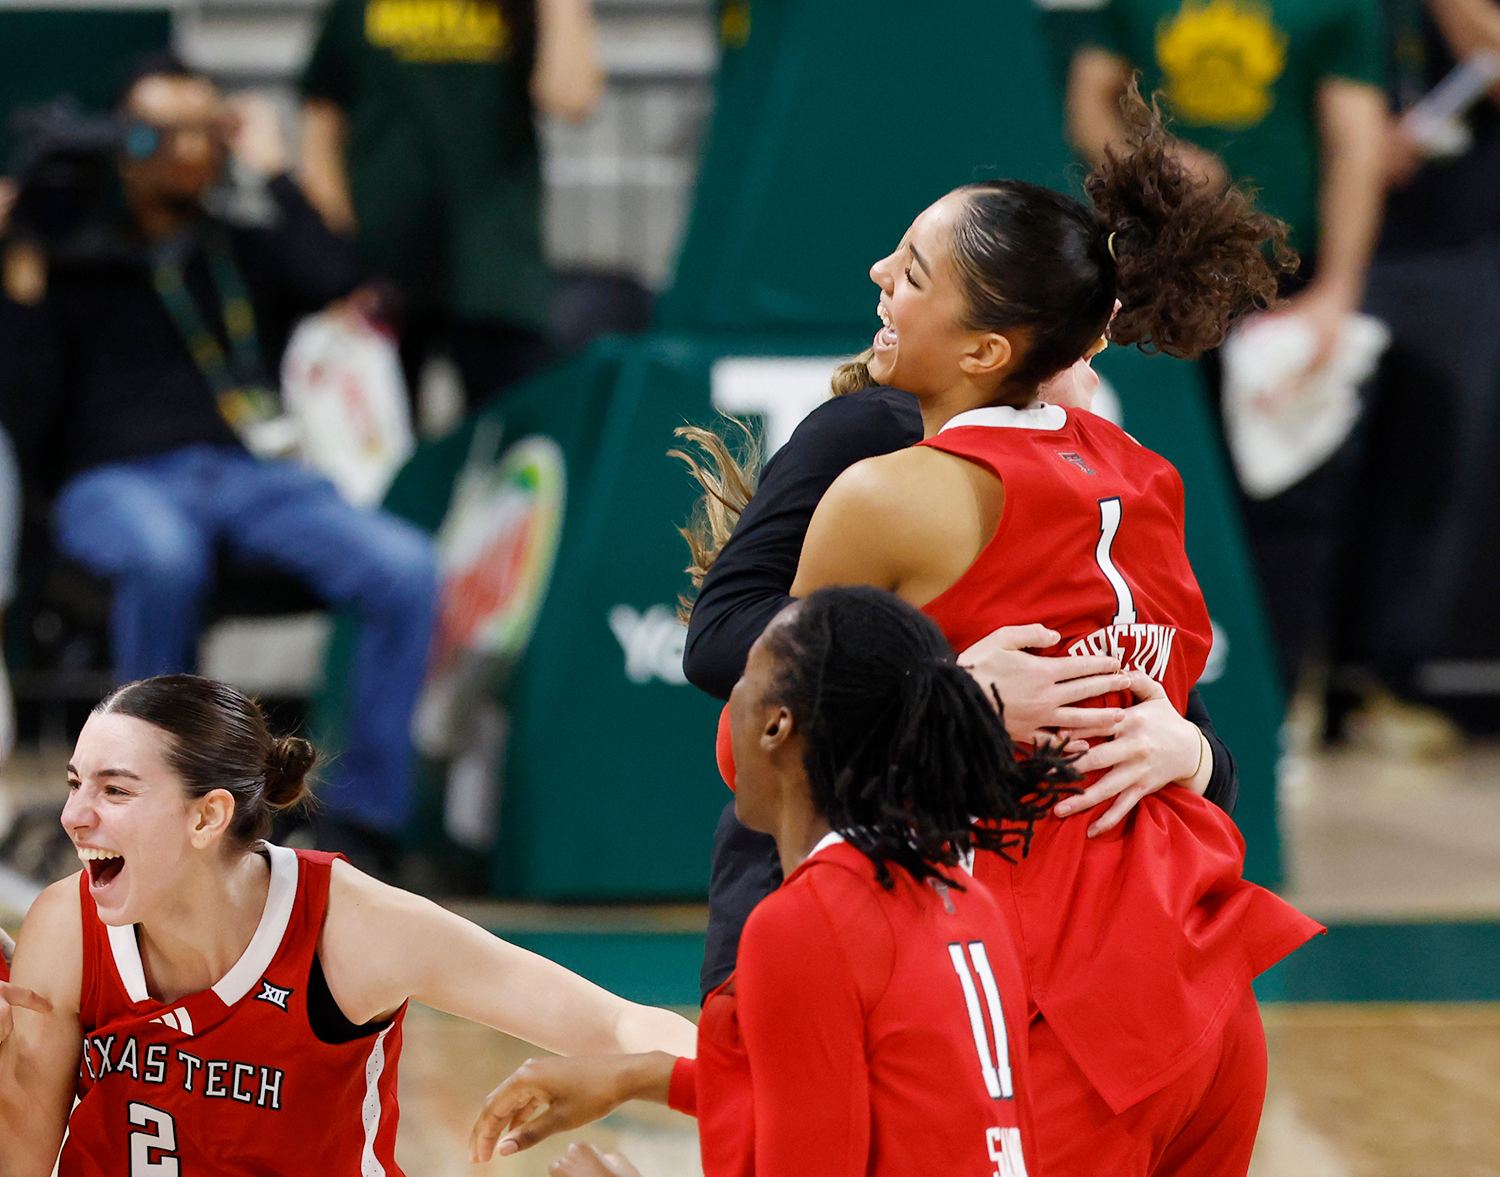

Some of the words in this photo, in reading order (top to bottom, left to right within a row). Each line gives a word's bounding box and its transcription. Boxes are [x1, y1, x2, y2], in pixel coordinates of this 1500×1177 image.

[1094, 495, 1138, 625] 1
[79, 1033, 169, 1084] EXAS
[177, 1049, 285, 1112] TECH
[947, 940, 1014, 1101] 11
